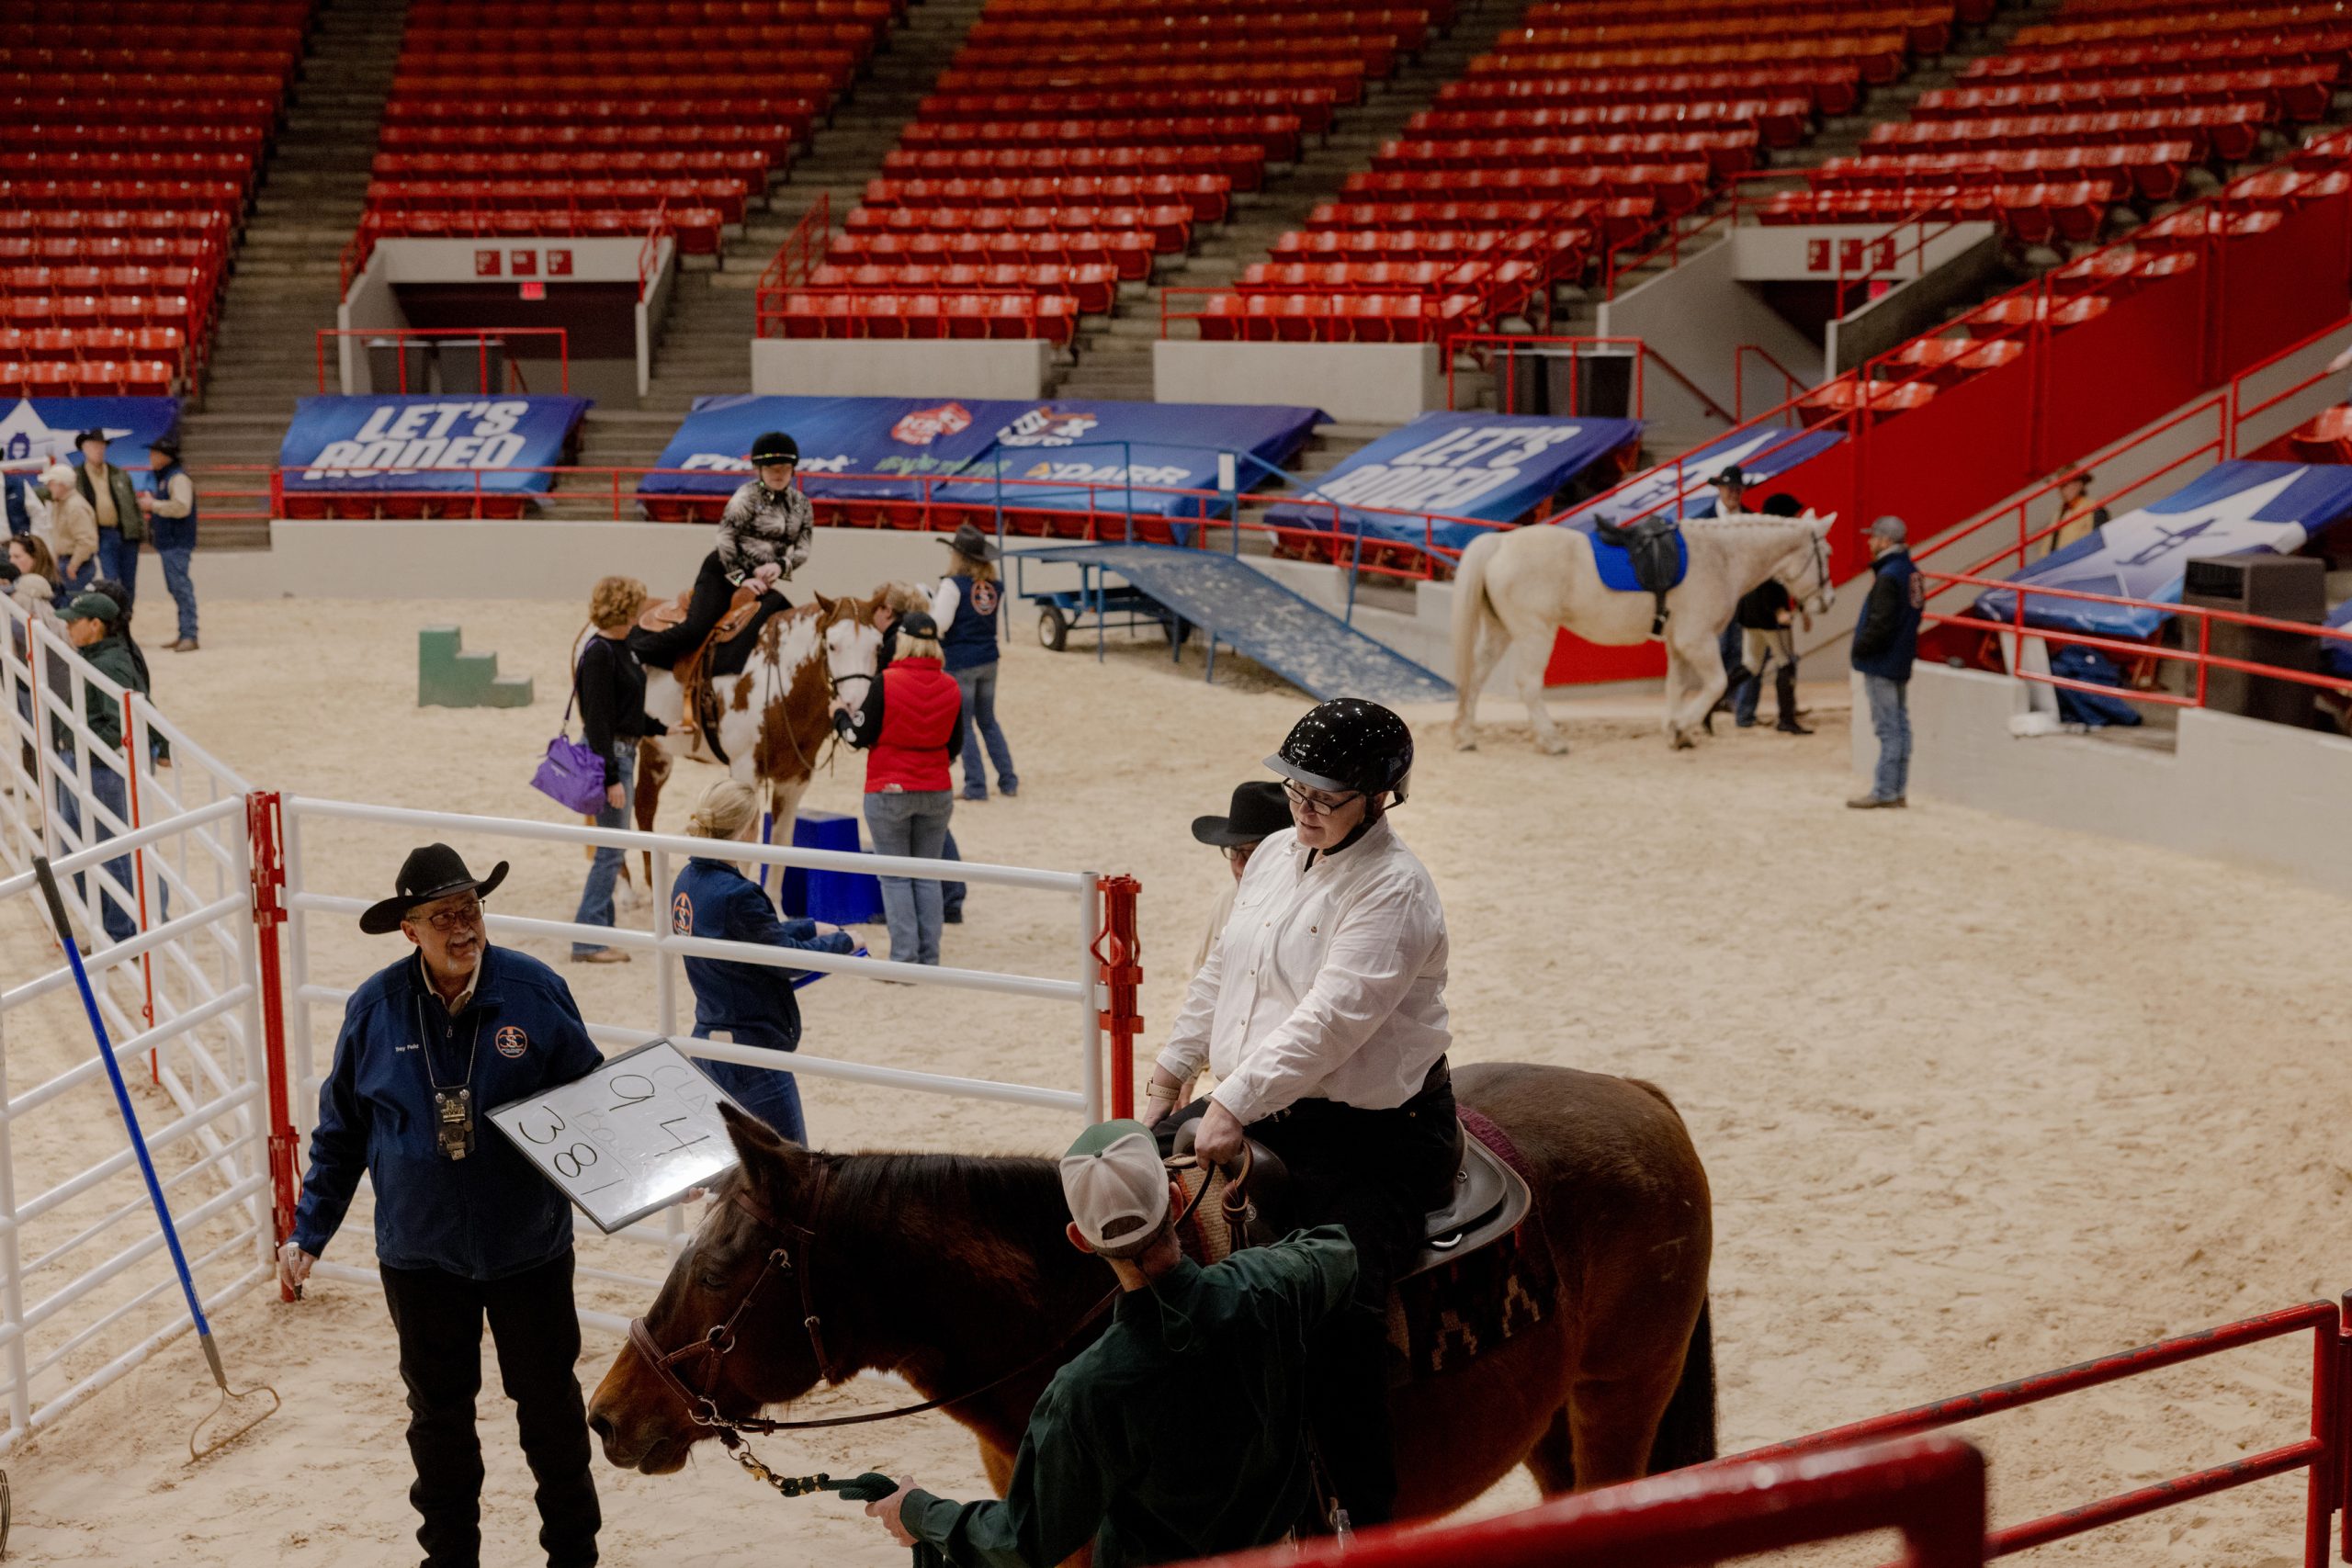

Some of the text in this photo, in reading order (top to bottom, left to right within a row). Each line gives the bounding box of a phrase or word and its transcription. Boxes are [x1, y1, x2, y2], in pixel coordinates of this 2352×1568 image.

[355, 400, 528, 442] LET'S
[303, 433, 526, 479] RODEO
[608, 1074, 710, 1157] 94
[518, 1105, 625, 1195] 381
